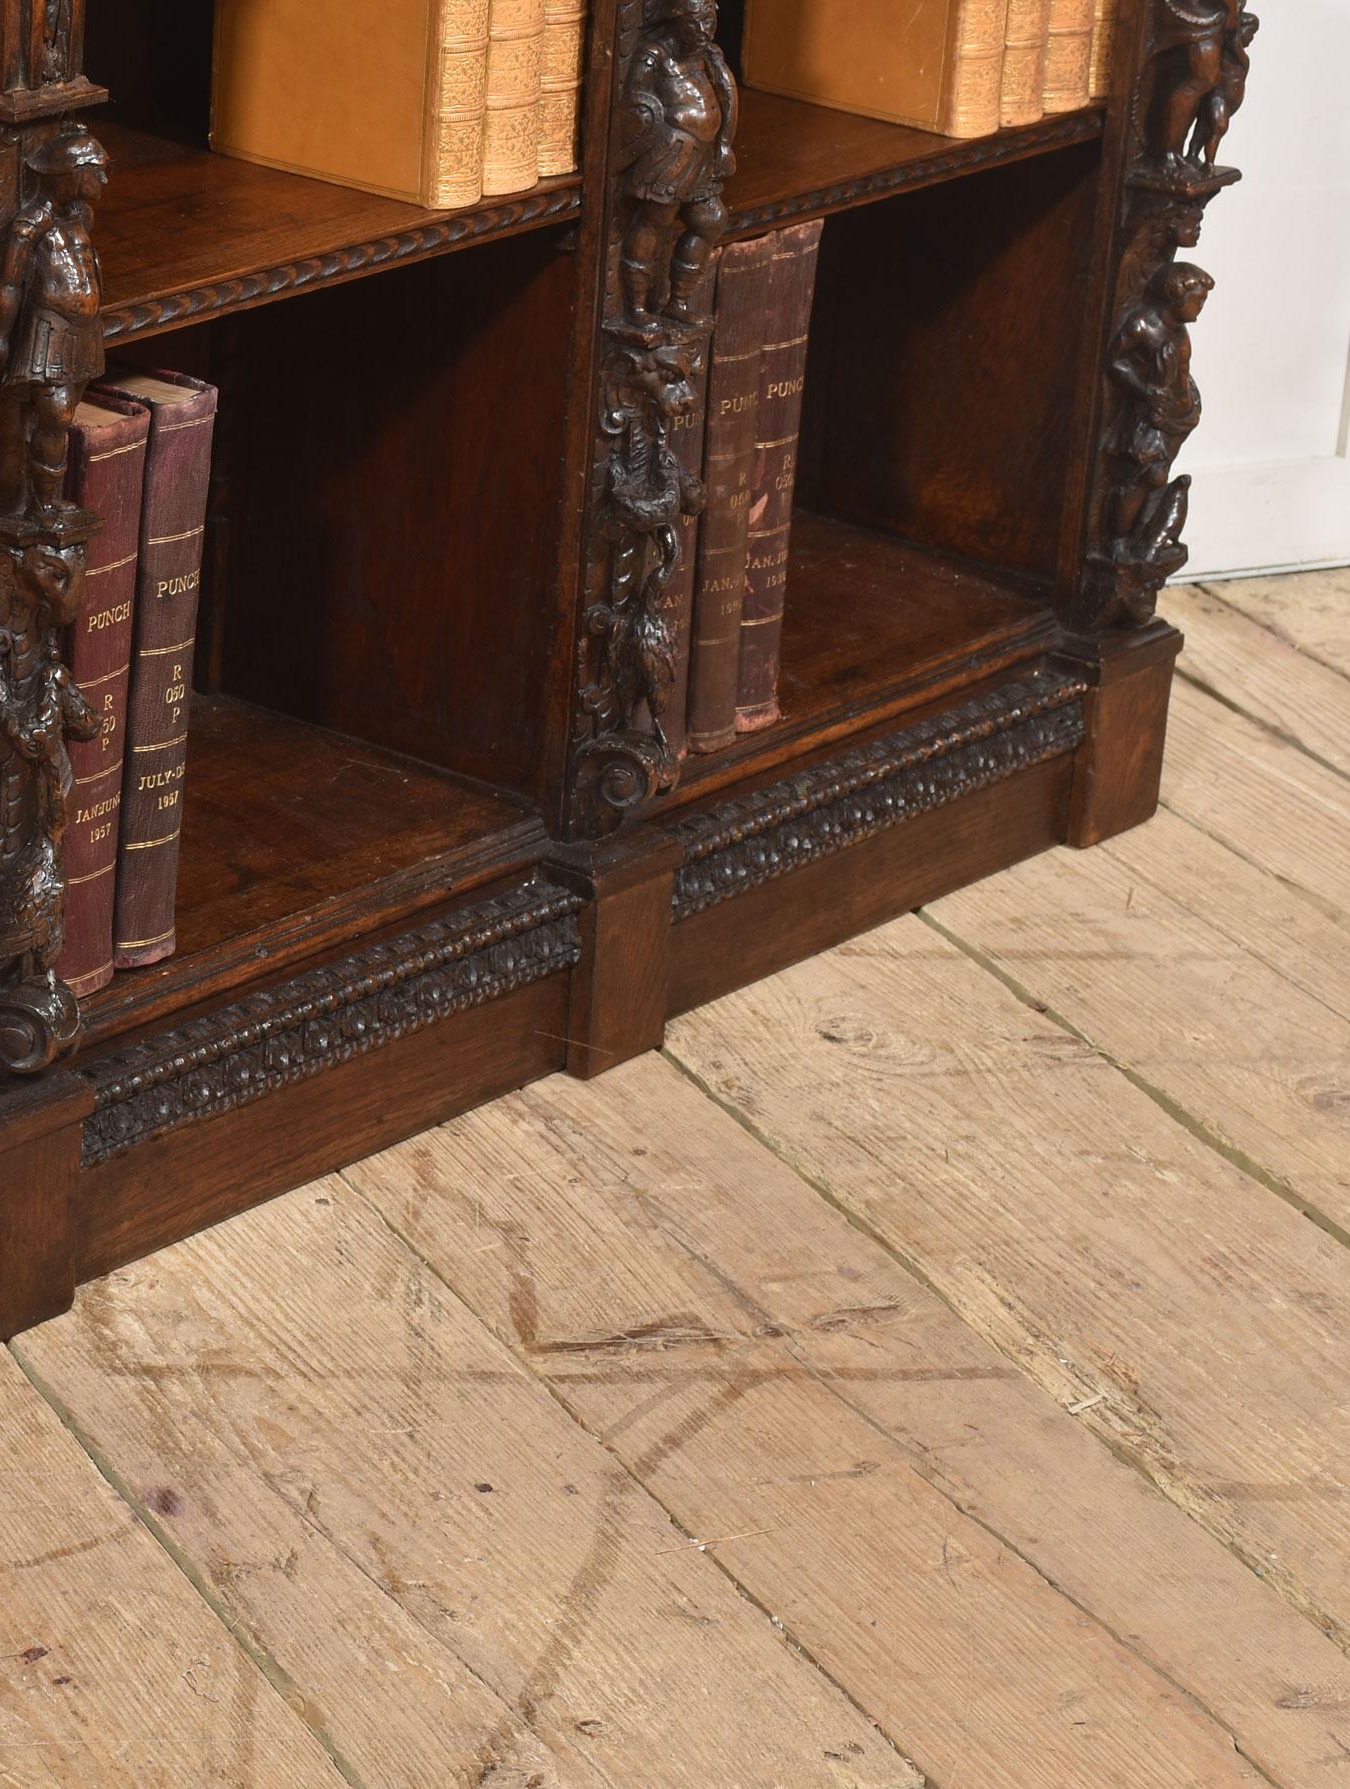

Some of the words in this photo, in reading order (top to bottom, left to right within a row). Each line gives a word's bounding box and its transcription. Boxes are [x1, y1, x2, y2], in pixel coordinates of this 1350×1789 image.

[157, 569, 200, 598] PUNCH
[87, 600, 131, 633] PUNCH
[172, 664, 182, 681] R
[103, 694, 113, 711] R
[166, 684, 185, 704] 050
[172, 707, 180, 724] P
[102, 736, 110, 751] P
[158, 790, 179, 810] 1957
[90, 822, 111, 843] 1957
